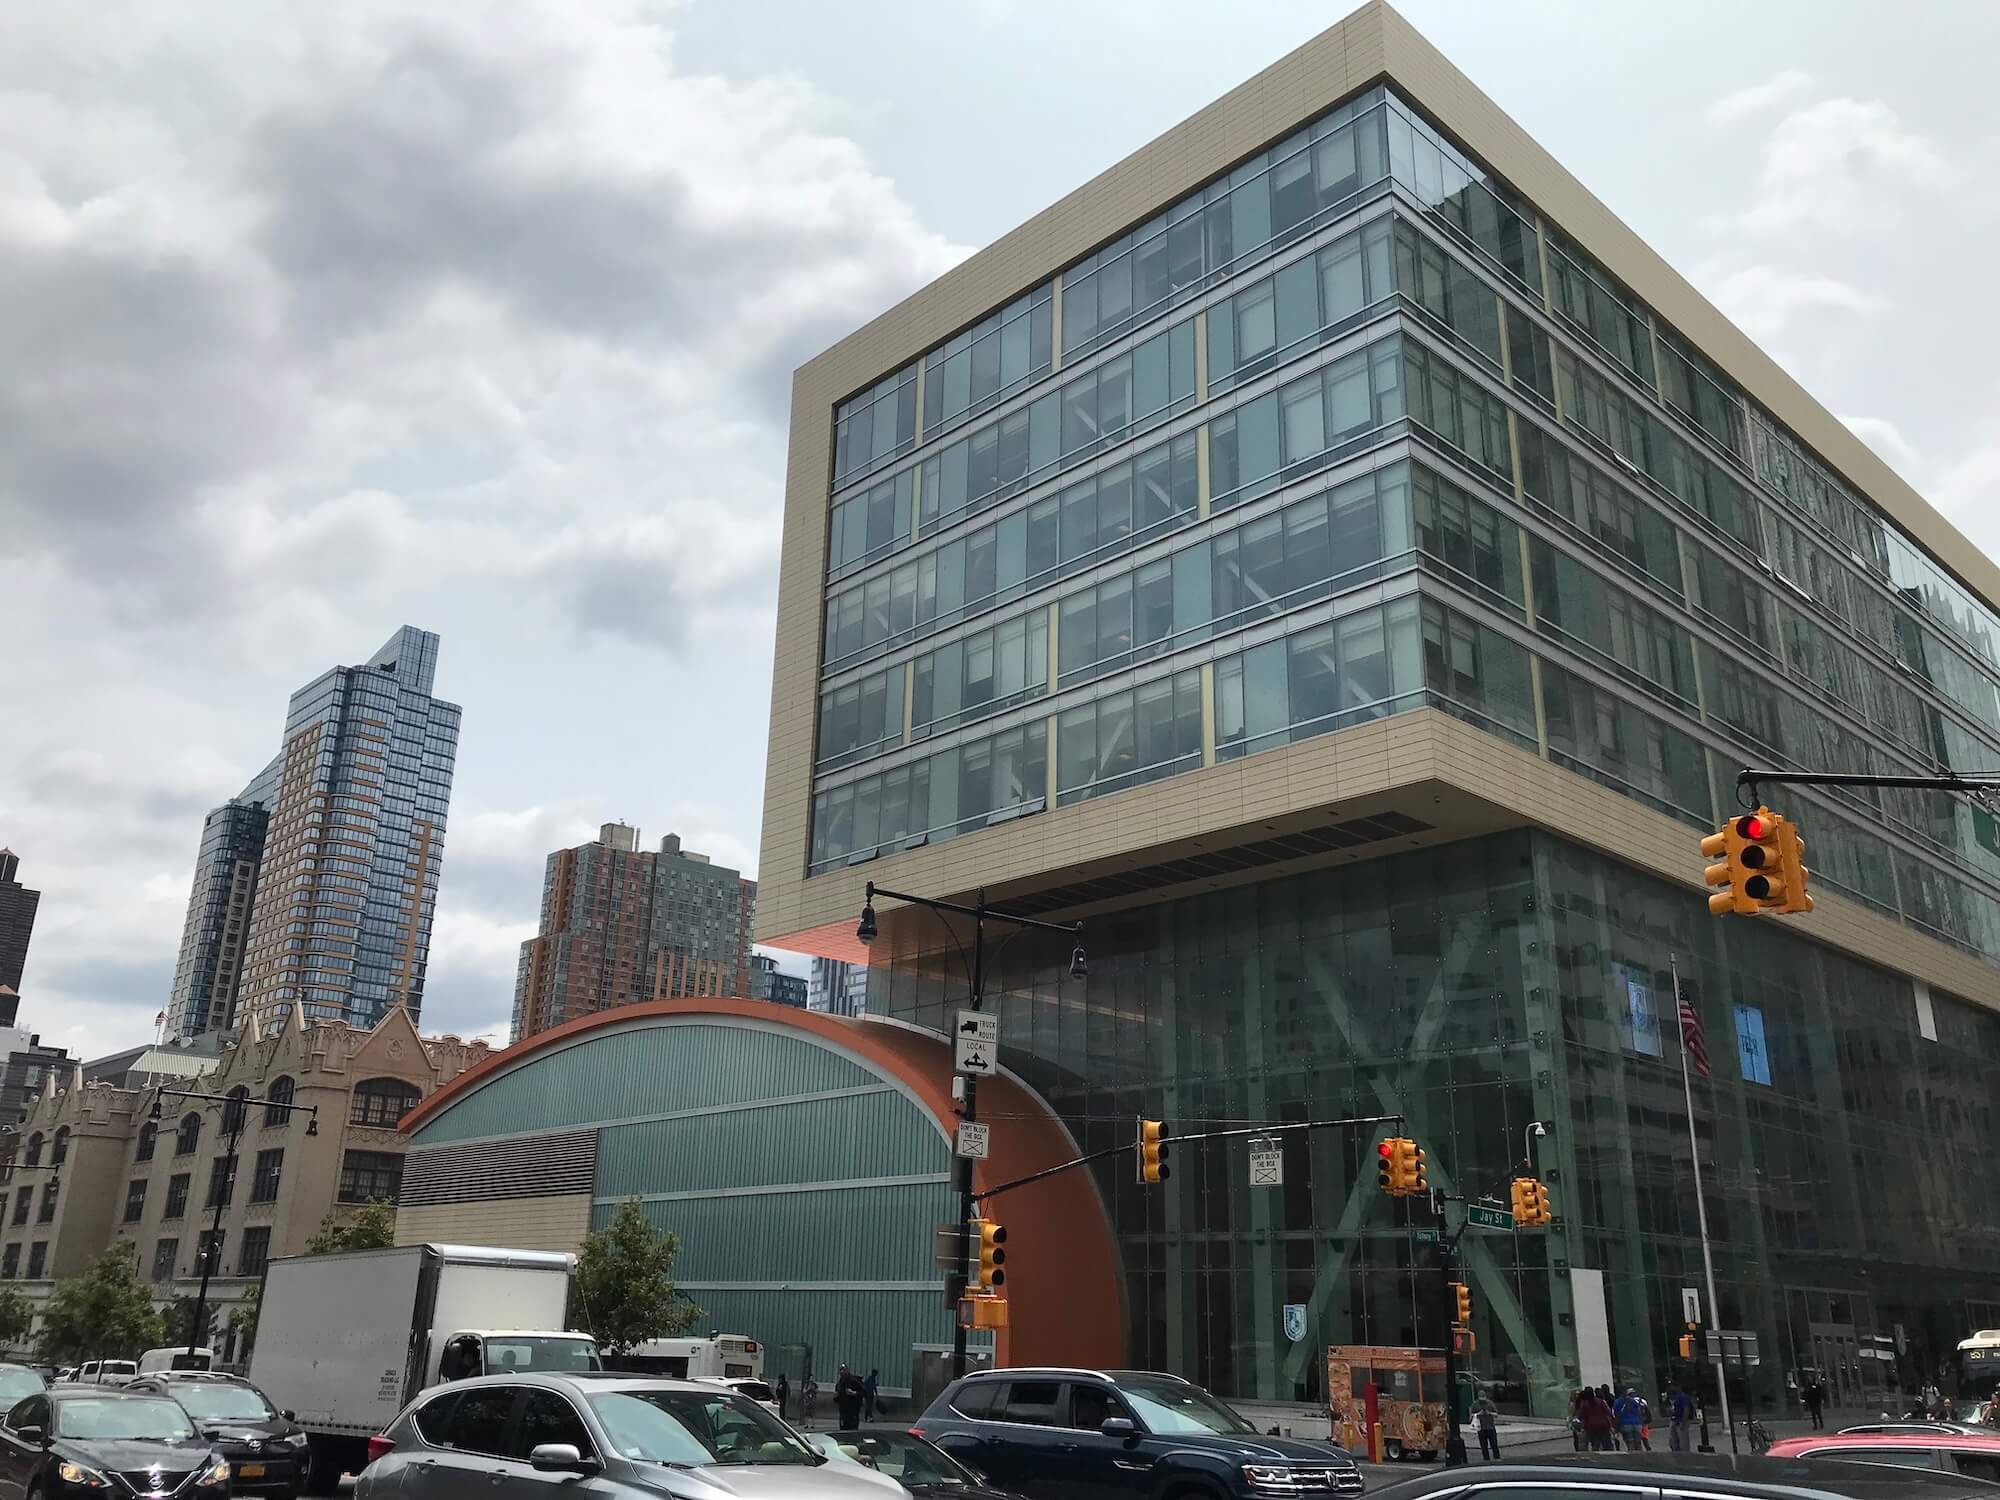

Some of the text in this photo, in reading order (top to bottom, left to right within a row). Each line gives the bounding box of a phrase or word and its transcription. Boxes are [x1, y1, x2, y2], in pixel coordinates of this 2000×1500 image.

[979, 1020, 996, 1029] TRUCK
[979, 1031, 995, 1040] ROUTE
[966, 1042, 986, 1051] LOCAL
[1480, 1211, 1503, 1225] Jay St
